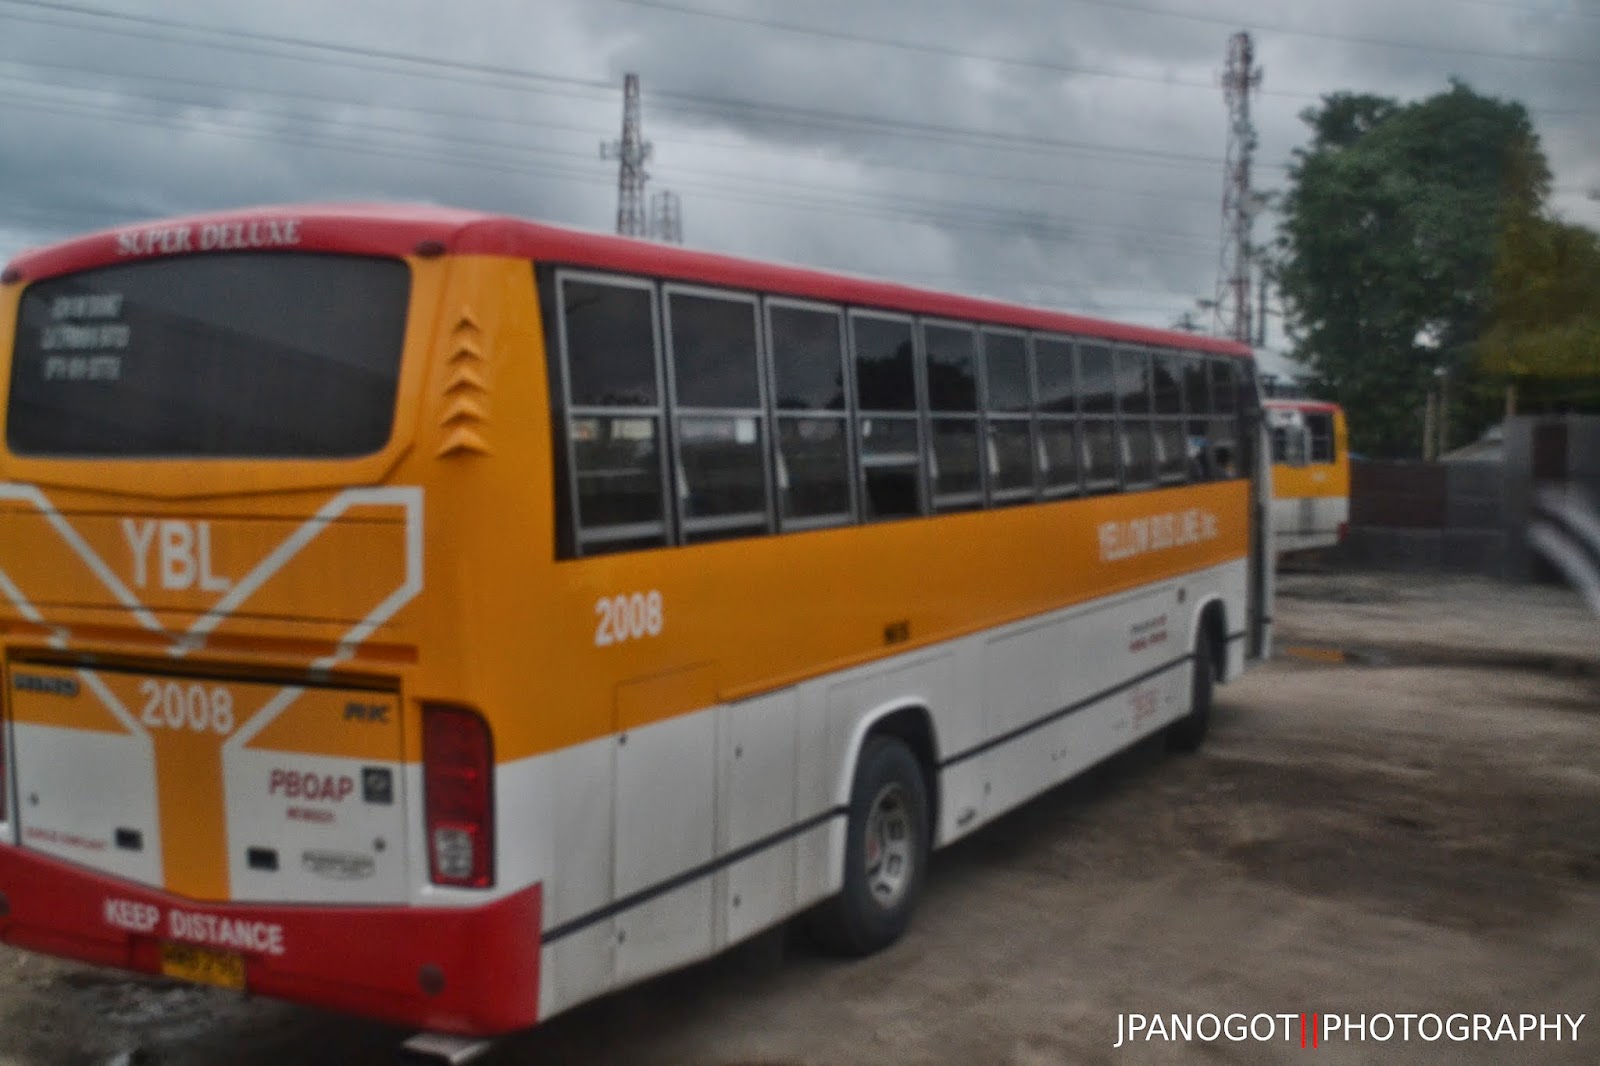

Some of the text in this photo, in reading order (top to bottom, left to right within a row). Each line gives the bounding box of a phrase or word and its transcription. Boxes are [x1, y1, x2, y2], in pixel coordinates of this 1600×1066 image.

[116, 219, 302, 256] SUPER DELUXE
[122, 519, 232, 592] YBL
[594, 590, 664, 648] 2008
[140, 681, 235, 735] 2008
[270, 768, 354, 802] PBOAP
[104, 898, 285, 955] KEEP DISTANCE
